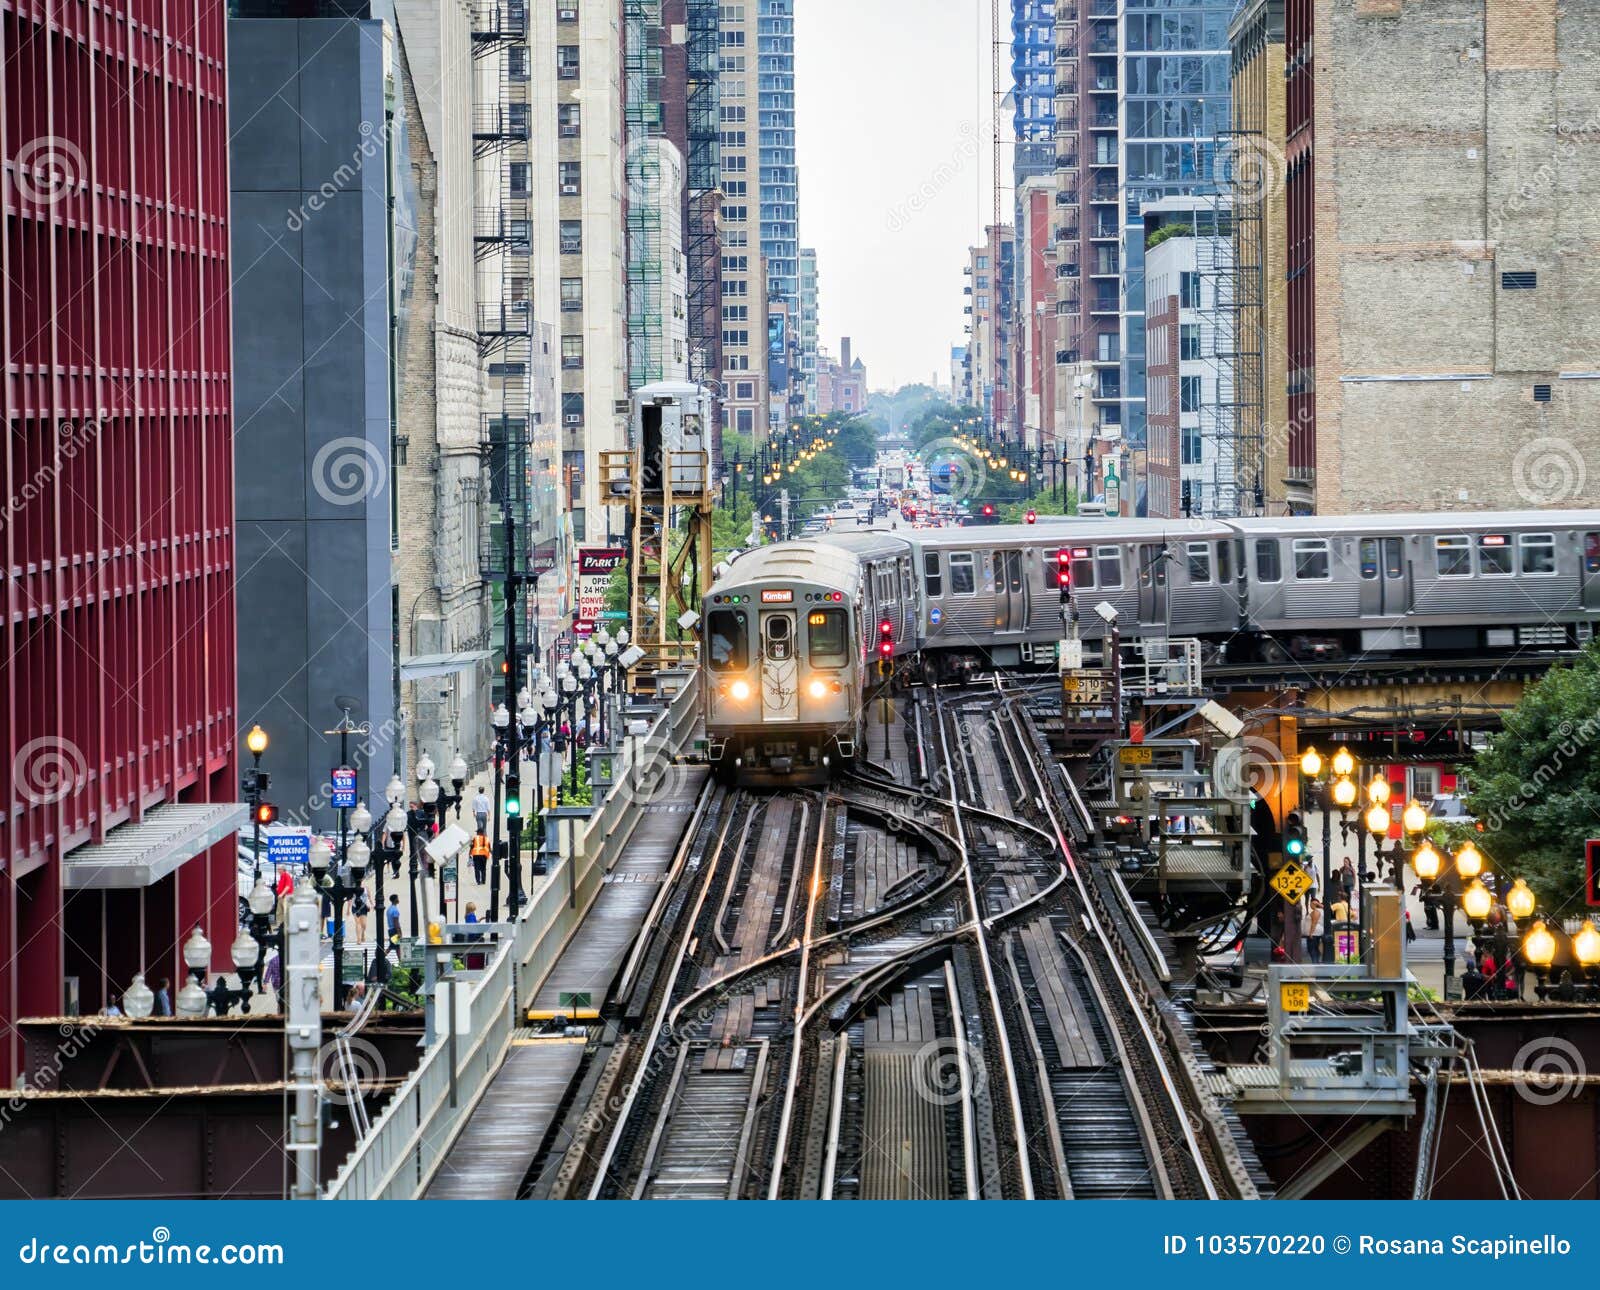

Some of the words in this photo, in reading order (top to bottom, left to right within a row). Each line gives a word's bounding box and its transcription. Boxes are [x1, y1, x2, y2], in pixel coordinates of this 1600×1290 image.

[584, 557, 612, 567] PARK
[584, 586, 593, 594] 24
[763, 591, 792, 601] Kimball
[1137, 749, 1150, 759] 35
[273, 838, 303, 846] PUBLIC
[269, 847, 307, 855] PARKING
[1287, 988, 1305, 997] LP2
